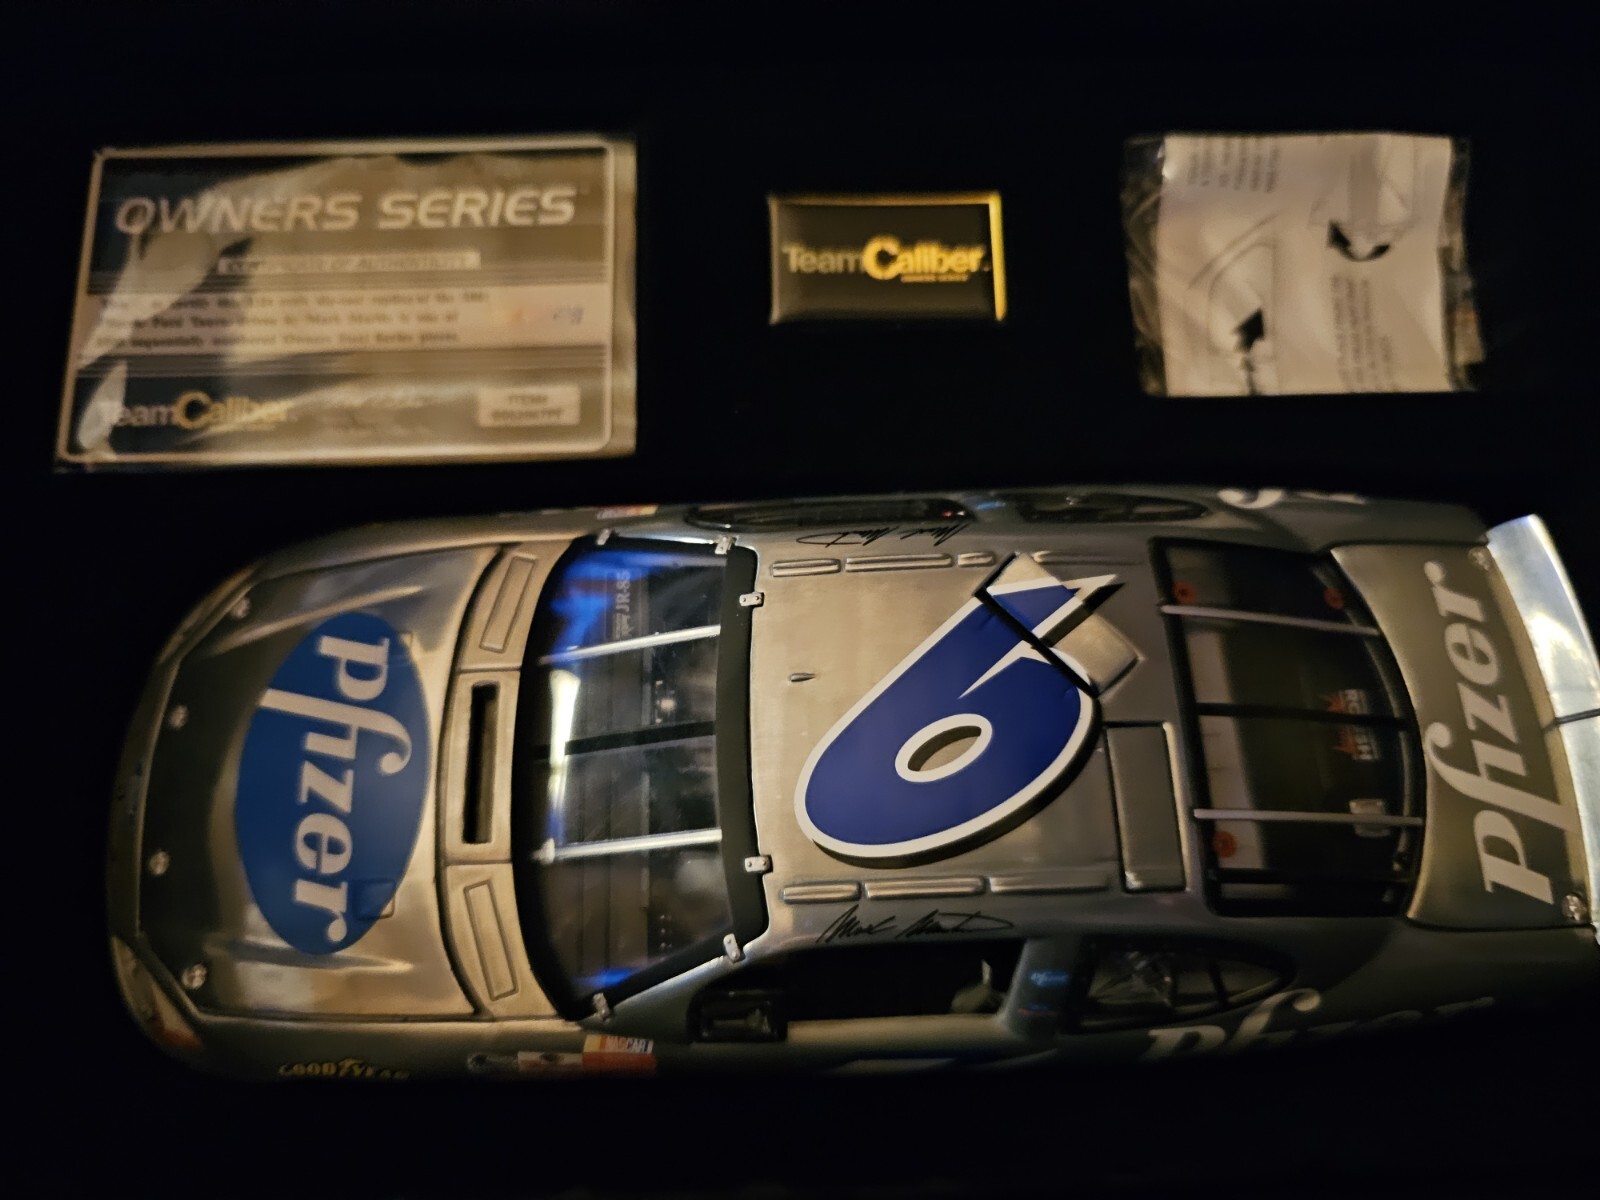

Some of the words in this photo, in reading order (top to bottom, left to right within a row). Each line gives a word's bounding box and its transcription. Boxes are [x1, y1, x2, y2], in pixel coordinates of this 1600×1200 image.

[113, 193, 362, 236] OWNERS
[377, 186, 577, 230] SERIES
[258, 635, 412, 943] Pfizer
[794, 573, 1119, 858] 6
[1424, 561, 1583, 905] Pfizer
